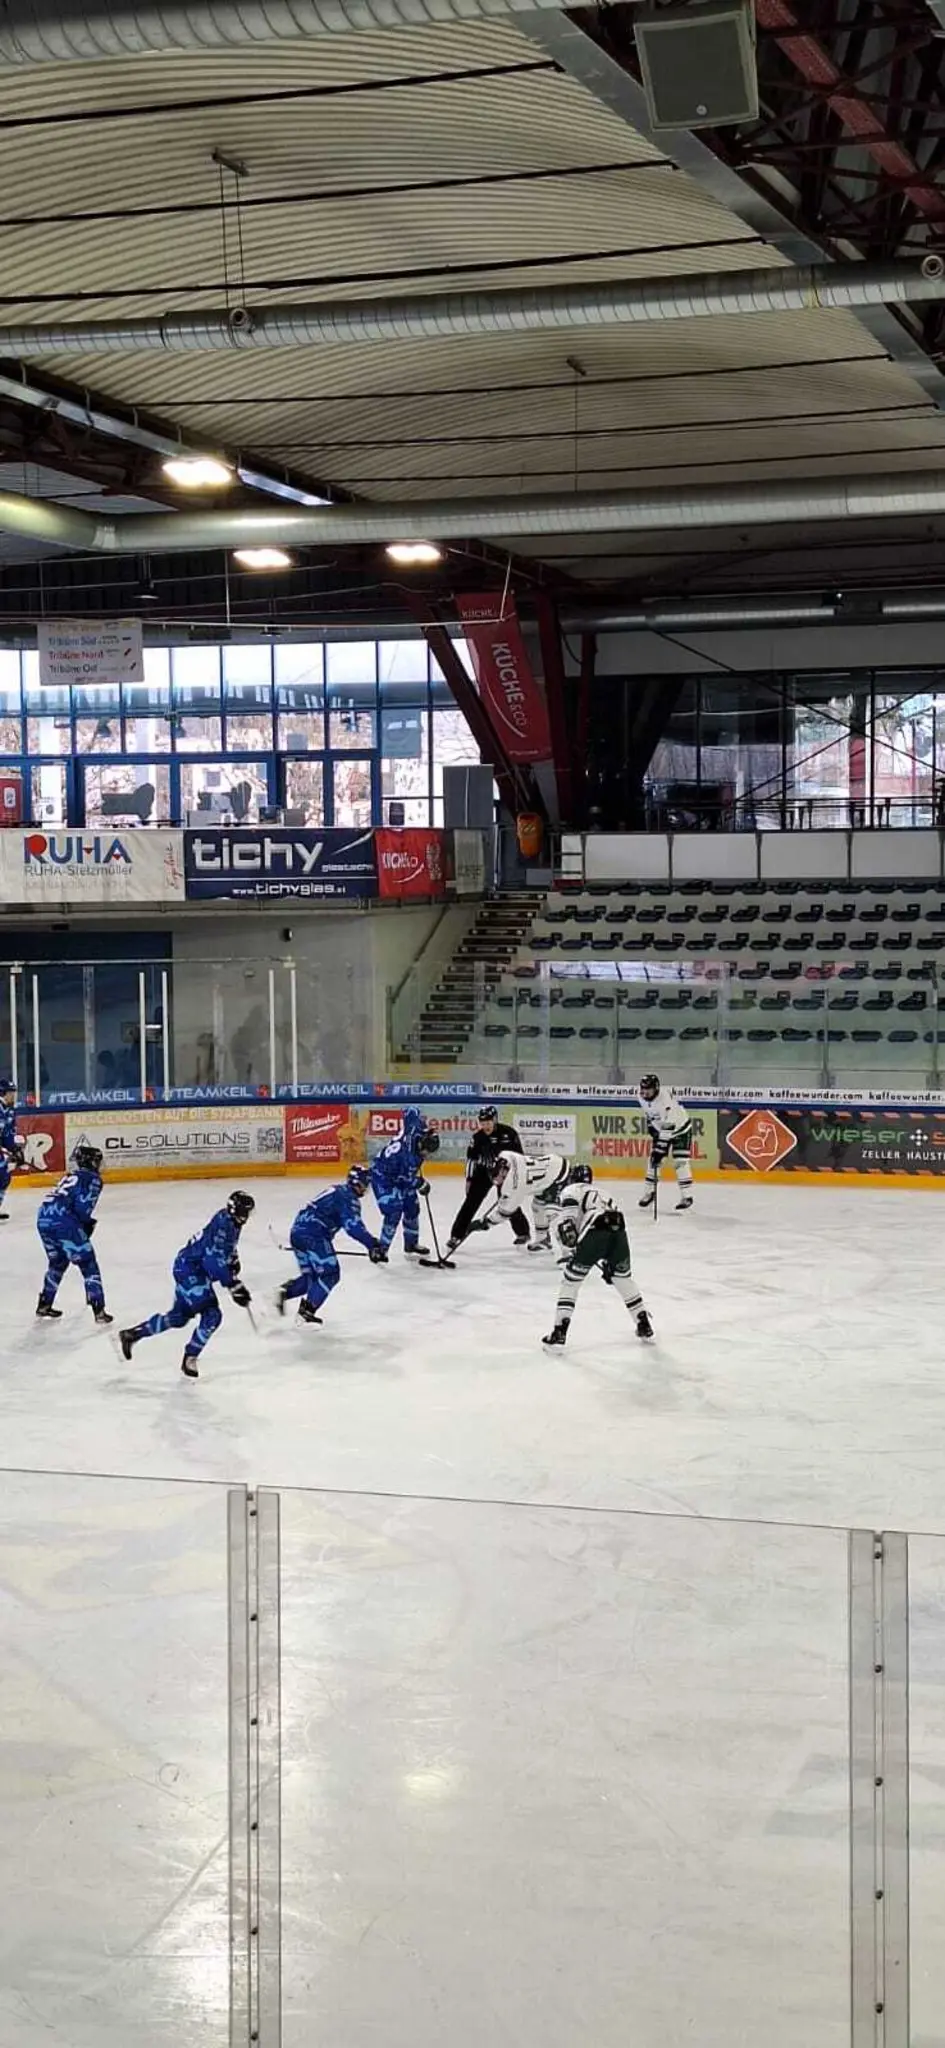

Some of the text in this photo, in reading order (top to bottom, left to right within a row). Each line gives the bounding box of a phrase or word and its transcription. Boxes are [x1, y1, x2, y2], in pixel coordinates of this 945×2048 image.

[24, 834, 132, 864] RUHA
[192, 837, 324, 874] tichy
[278, 1084, 369, 1097] #TEAMKEIL
[392, 1083, 477, 1096] #TEAMKEIL
[482, 1084, 571, 1097] kaffeewunder.com
[671, 1086, 764, 1099] kaffeewunder.com
[769, 1089, 863, 1101] kaffeewunder.com
[49, 1089, 136, 1105] #TEAMKEIL
[518, 1118, 569, 1130] eurogast
[592, 1115, 626, 1135] WIR
[105, 1131, 251, 1150] CL SOLUTIONS
[811, 1127, 908, 1143] wieser
[861, 1150, 901, 1160] ZELLER
